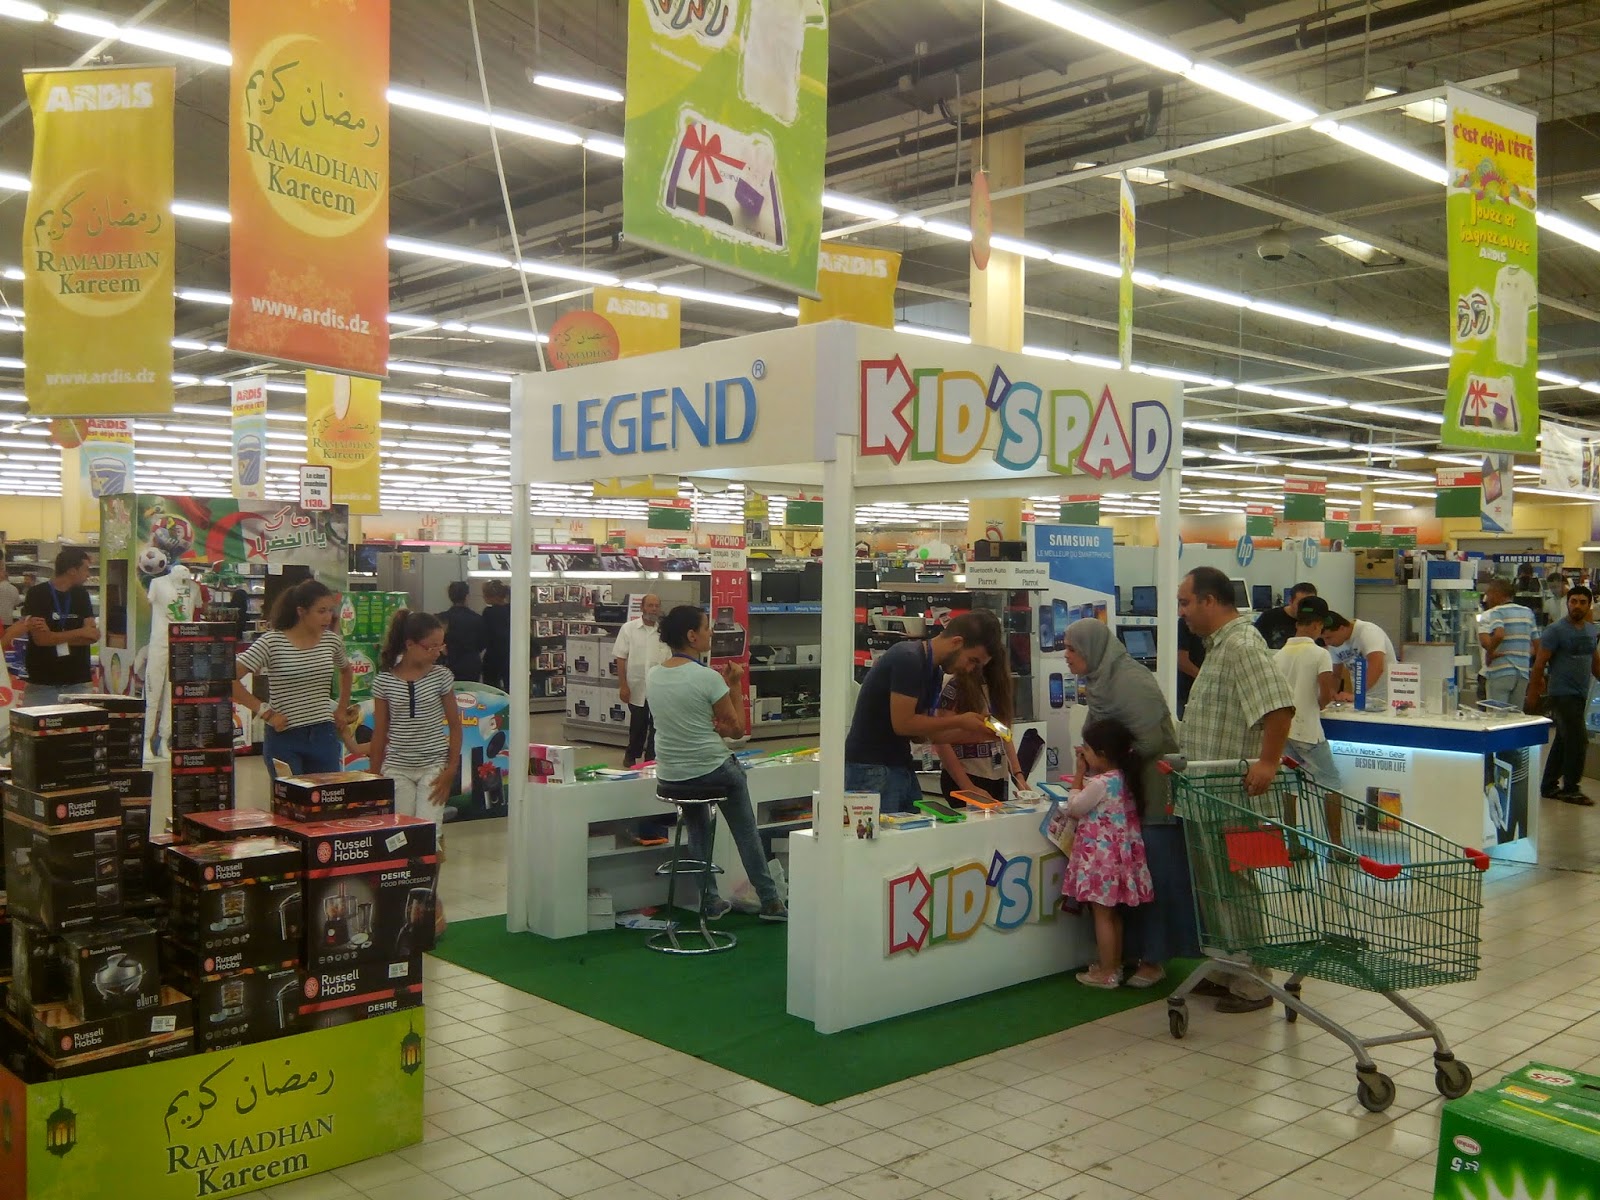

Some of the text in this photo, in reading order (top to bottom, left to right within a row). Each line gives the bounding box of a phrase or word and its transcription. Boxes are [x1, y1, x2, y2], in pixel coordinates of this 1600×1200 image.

[46, 82, 153, 112] ARDIS
[245, 60, 381, 147] رمضان كريم
[246, 122, 379, 191] RAMADHAN
[267, 163, 356, 216] Kareem
[34, 191, 162, 245] رمضان كريم
[35, 250, 160, 272] RAMADHAN
[1479, 247, 1507, 263] ARDIS
[817, 252, 888, 278] ARDIS
[59, 274, 141, 294] Kareem
[250, 295, 370, 335] www.ardis.dz
[606, 297, 669, 319] ARDIS
[236, 387, 262, 402] ARDIS
[552, 376, 757, 462] LEGEND
[323, 449, 365, 459] Kareem
[715, 535, 740, 547] PROMO
[1050, 534, 1100, 547] SAMSUNG
[1238, 536, 1253, 566] hp
[1305, 537, 1317, 567] hp
[1500, 555, 1541, 563] SAMSUNG
[1022, 578, 1039, 586] Parrot
[351, 665, 370, 674] HAT
[1360, 748, 1375, 756] Note
[1389, 750, 1406, 758] Gear
[1355, 757, 1406, 772] DESIGN YOUR LIFE
[321, 788, 345, 797] Russell
[321, 795, 343, 803] Hobbs
[68, 800, 97, 810] Russell
[68, 808, 95, 818] Hobbs
[334, 837, 373, 851] Russell
[334, 849, 370, 862] Hobbs
[215, 862, 243, 873] Russell
[215, 870, 241, 880] Hobbs
[380, 876, 431, 888] FOOD PROCESSOR
[381, 870, 411, 881] DESIRE
[889, 849, 1034, 955] KID'S
[215, 952, 242, 964] Russell
[215, 961, 240, 971] Hobbs
[321, 969, 359, 986] Russell
[321, 982, 356, 996] Hobbs
[368, 1000, 398, 1013] DESIRE
[73, 1028, 104, 1042] Russell
[74, 1037, 102, 1048] Hobbs
[164, 1058, 336, 1142] رمضان كريم
[166, 1115, 334, 1175] RAMADHAN
[1456, 1138, 1479, 1152] Henkel
[195, 1150, 310, 1197] Kareem
